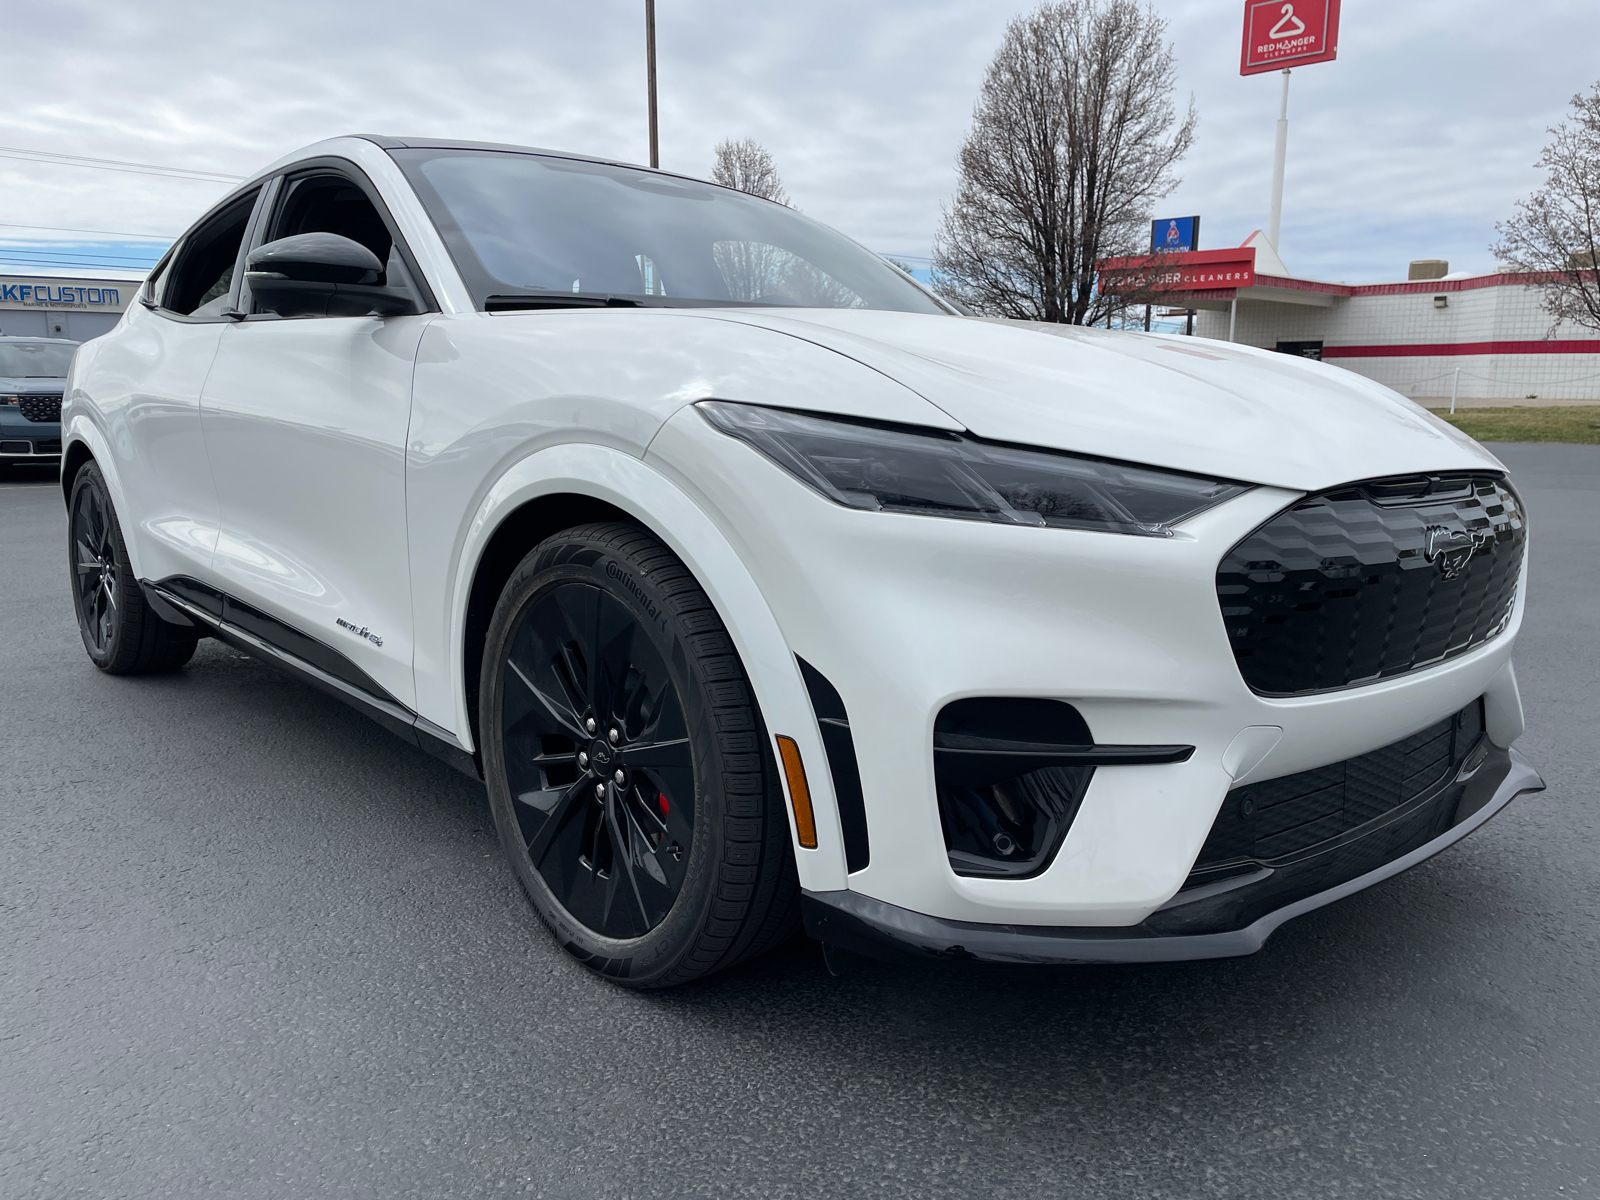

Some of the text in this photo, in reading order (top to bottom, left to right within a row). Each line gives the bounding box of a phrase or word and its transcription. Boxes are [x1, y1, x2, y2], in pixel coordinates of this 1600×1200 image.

[1257, 36, 1315, 53] RED HANGER
[1264, 46, 1307, 58] CLEANERS
[1184, 271, 1249, 283] CLEANERS
[0, 284, 119, 305] KFCUSTOM
[605, 560, 662, 622] Continental
